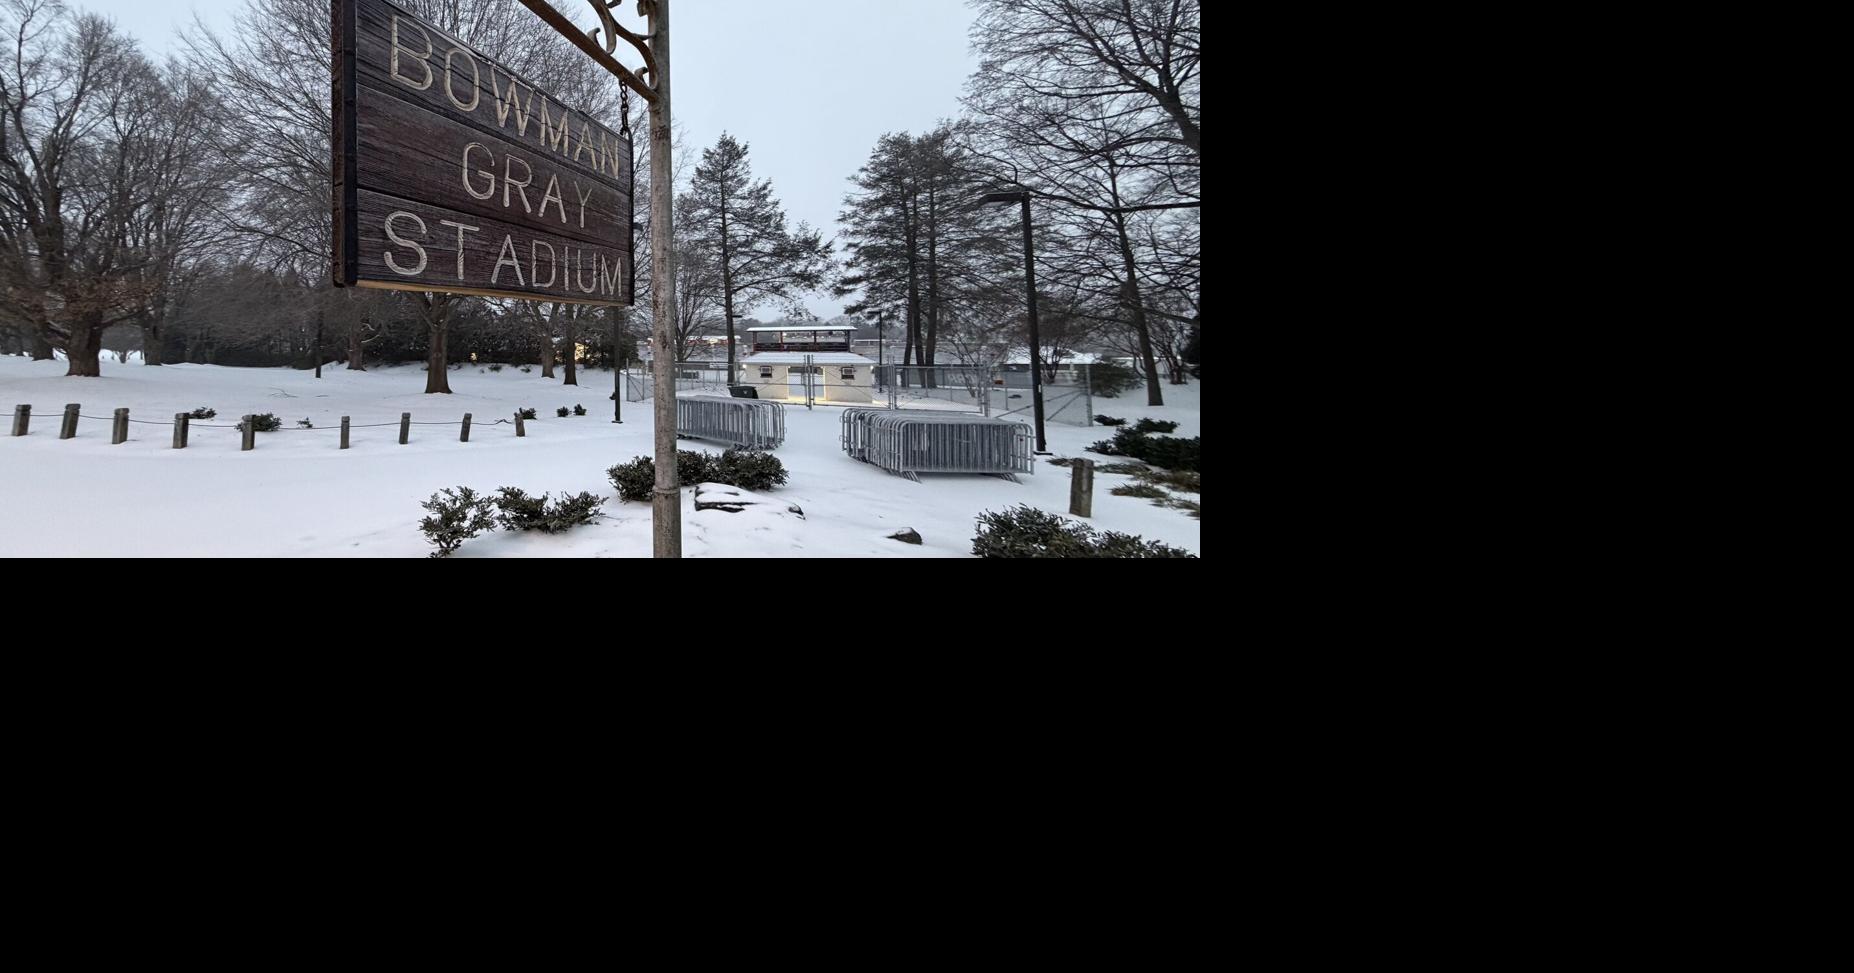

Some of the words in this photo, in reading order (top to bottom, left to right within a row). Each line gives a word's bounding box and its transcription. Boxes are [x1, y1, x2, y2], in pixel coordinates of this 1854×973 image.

[391, 14, 619, 180] BOWMAN
[462, 142, 593, 229] GRAY
[384, 210, 622, 297] STADIUM
